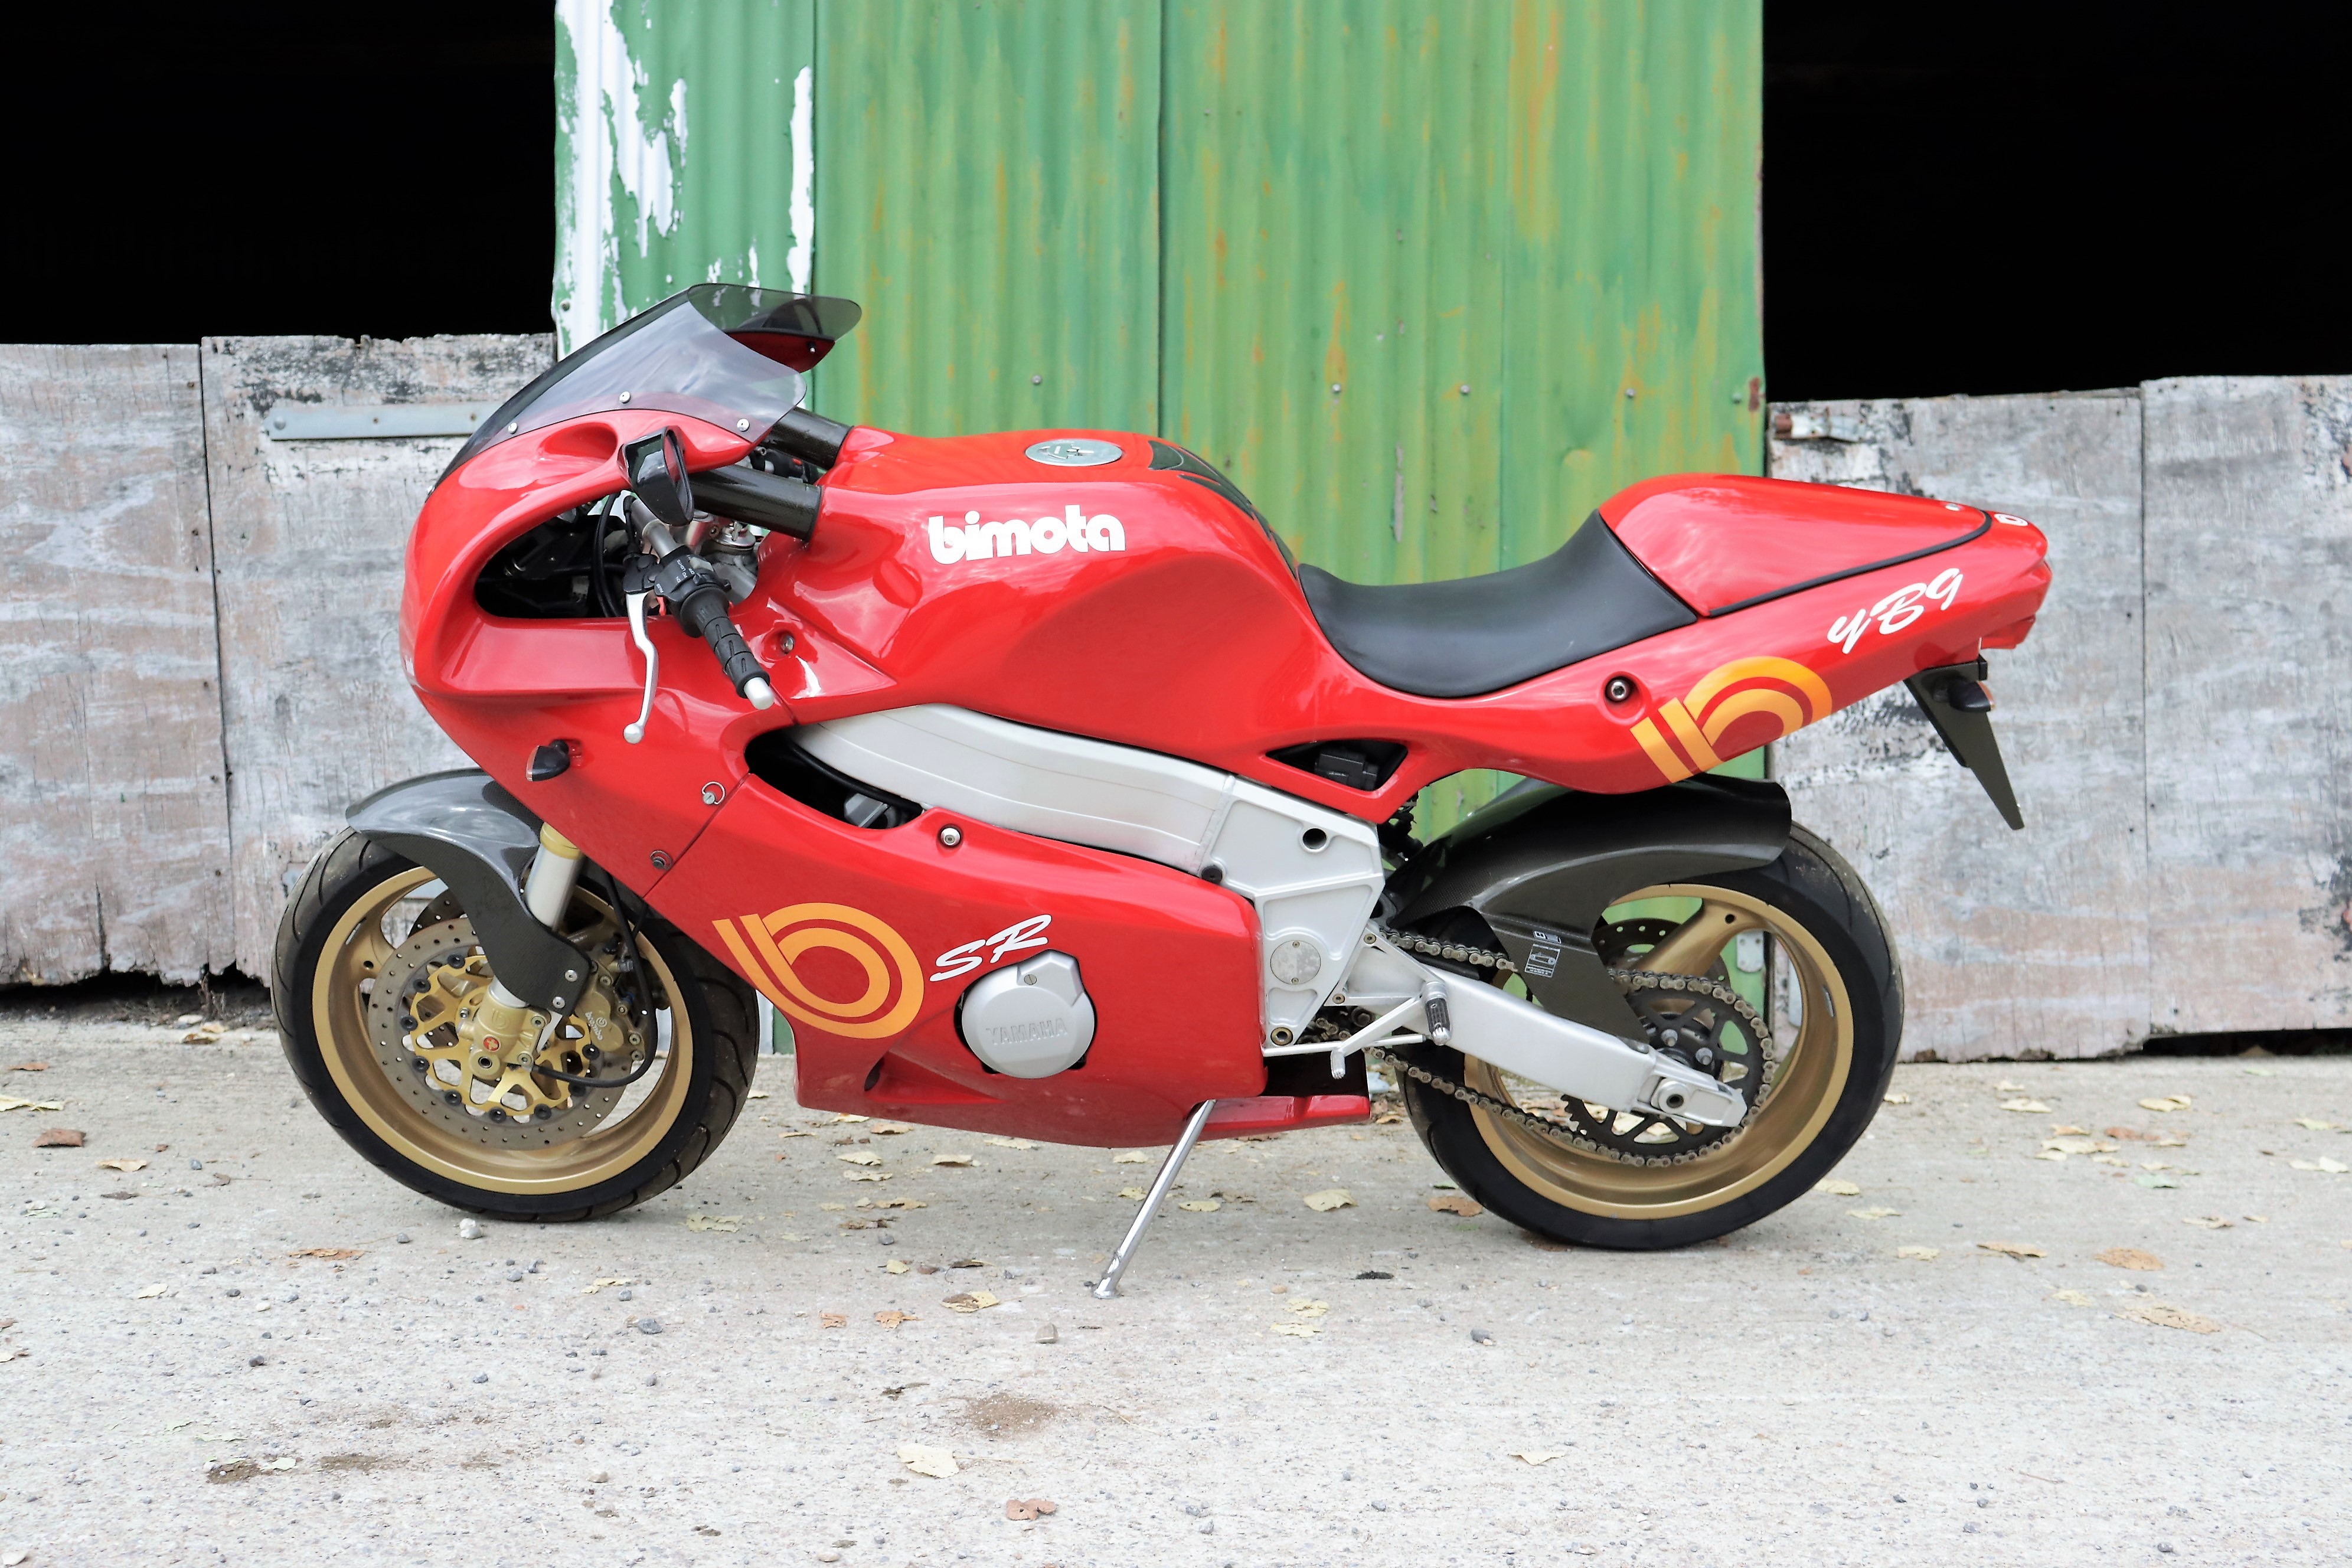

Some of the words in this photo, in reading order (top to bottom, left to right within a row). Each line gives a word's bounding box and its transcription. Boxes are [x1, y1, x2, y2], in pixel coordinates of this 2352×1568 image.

[927, 504, 1126, 564] bimota
[929, 914, 1052, 982] SR
[986, 1018, 1068, 1045] YAMAHA
